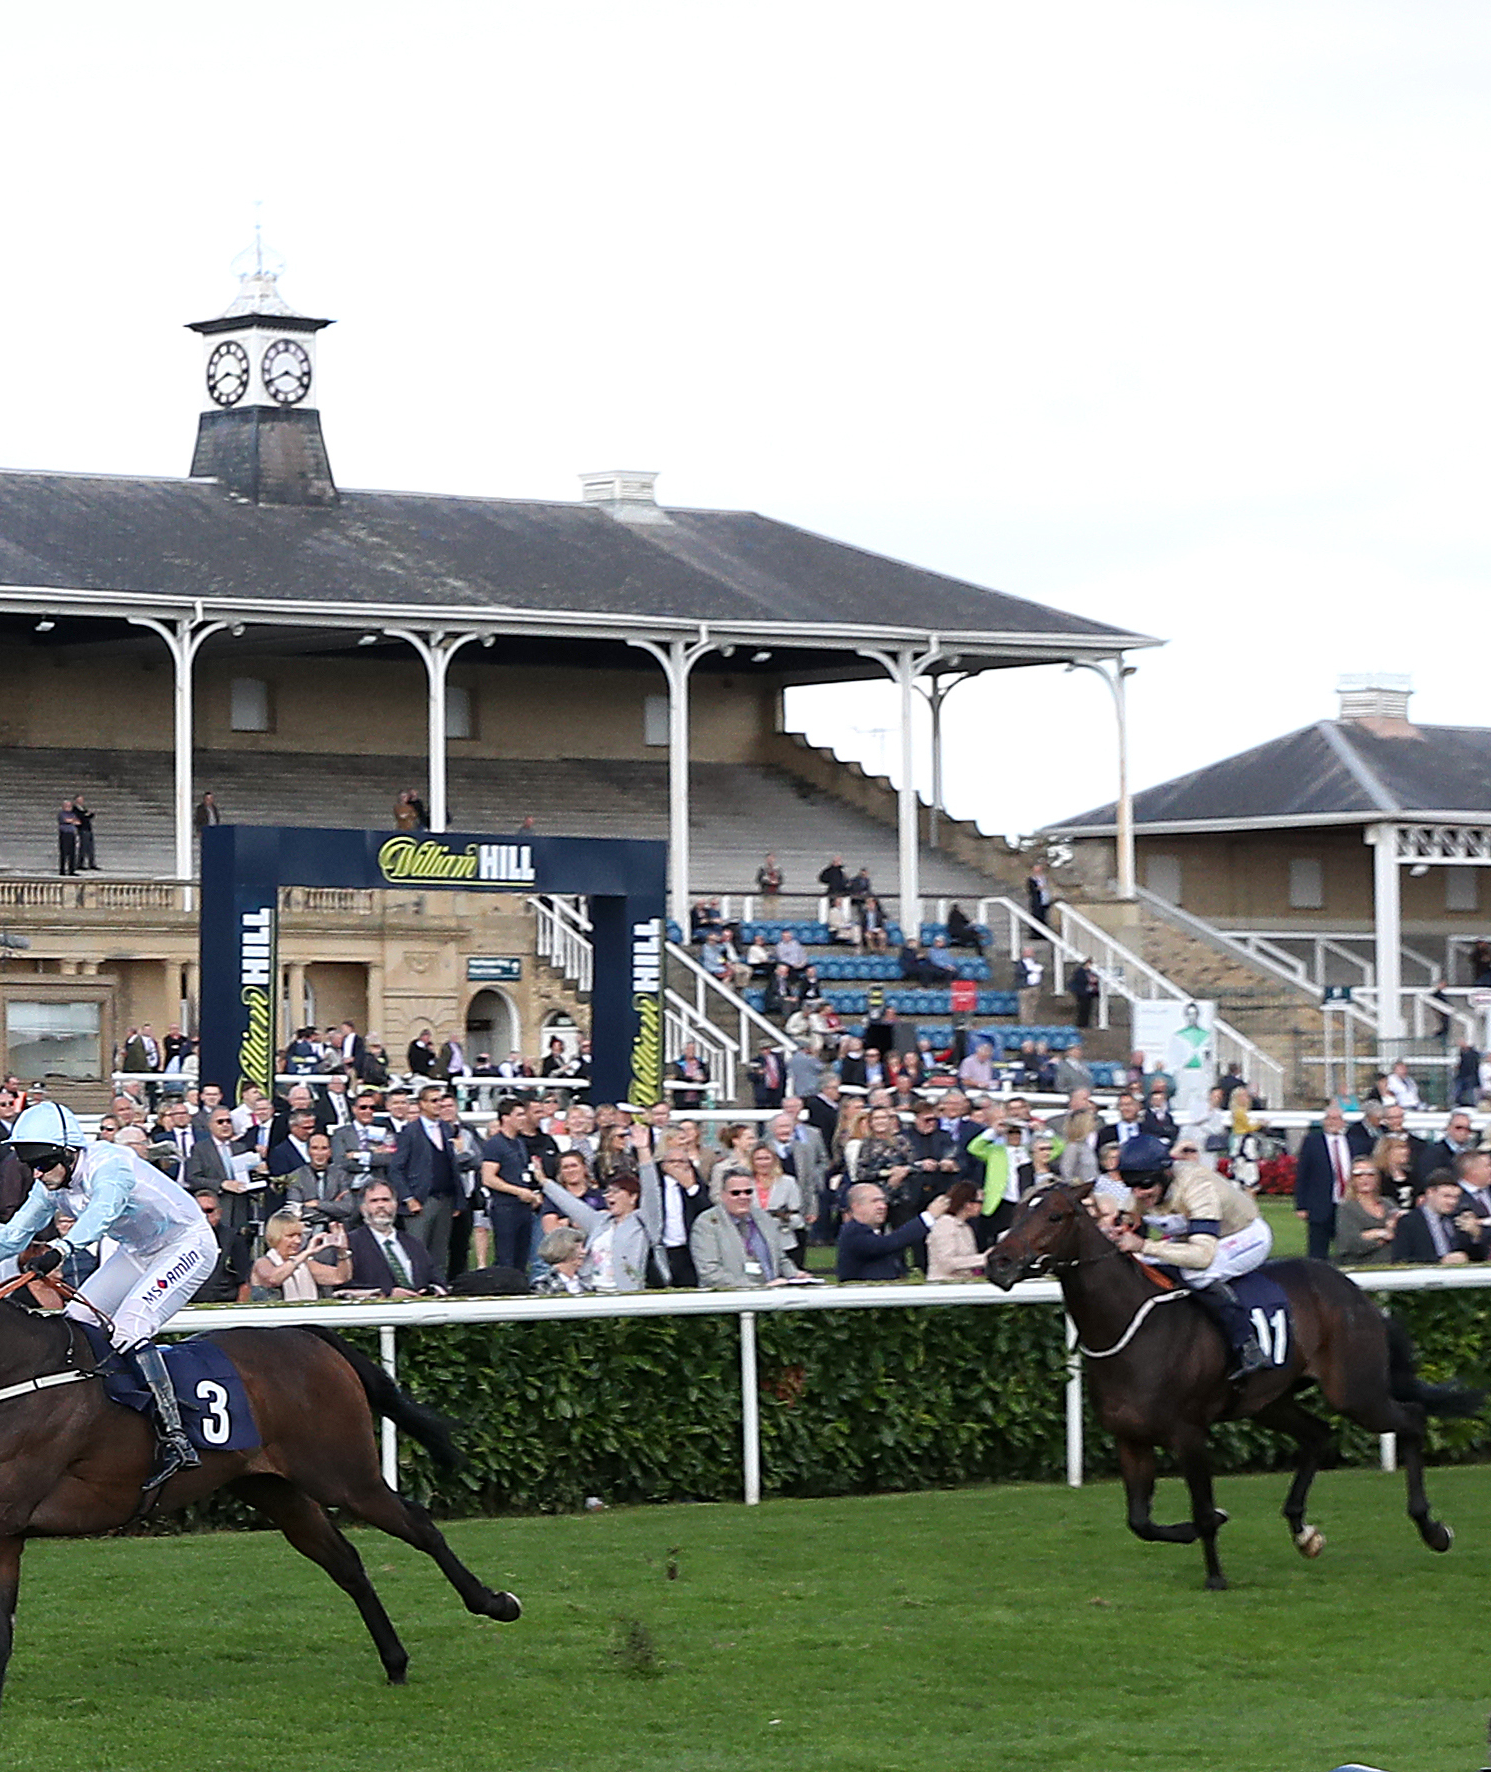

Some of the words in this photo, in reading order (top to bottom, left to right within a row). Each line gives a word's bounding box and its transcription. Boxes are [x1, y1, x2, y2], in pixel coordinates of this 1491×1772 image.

[379, 836, 479, 879] William
[479, 844, 535, 880] HILL
[241, 907, 270, 985] HILL
[632, 917, 660, 992] HILL
[141, 1285, 164, 1306] MS
[1250, 1307, 1288, 1364] 11
[196, 1379, 230, 1444] 3
